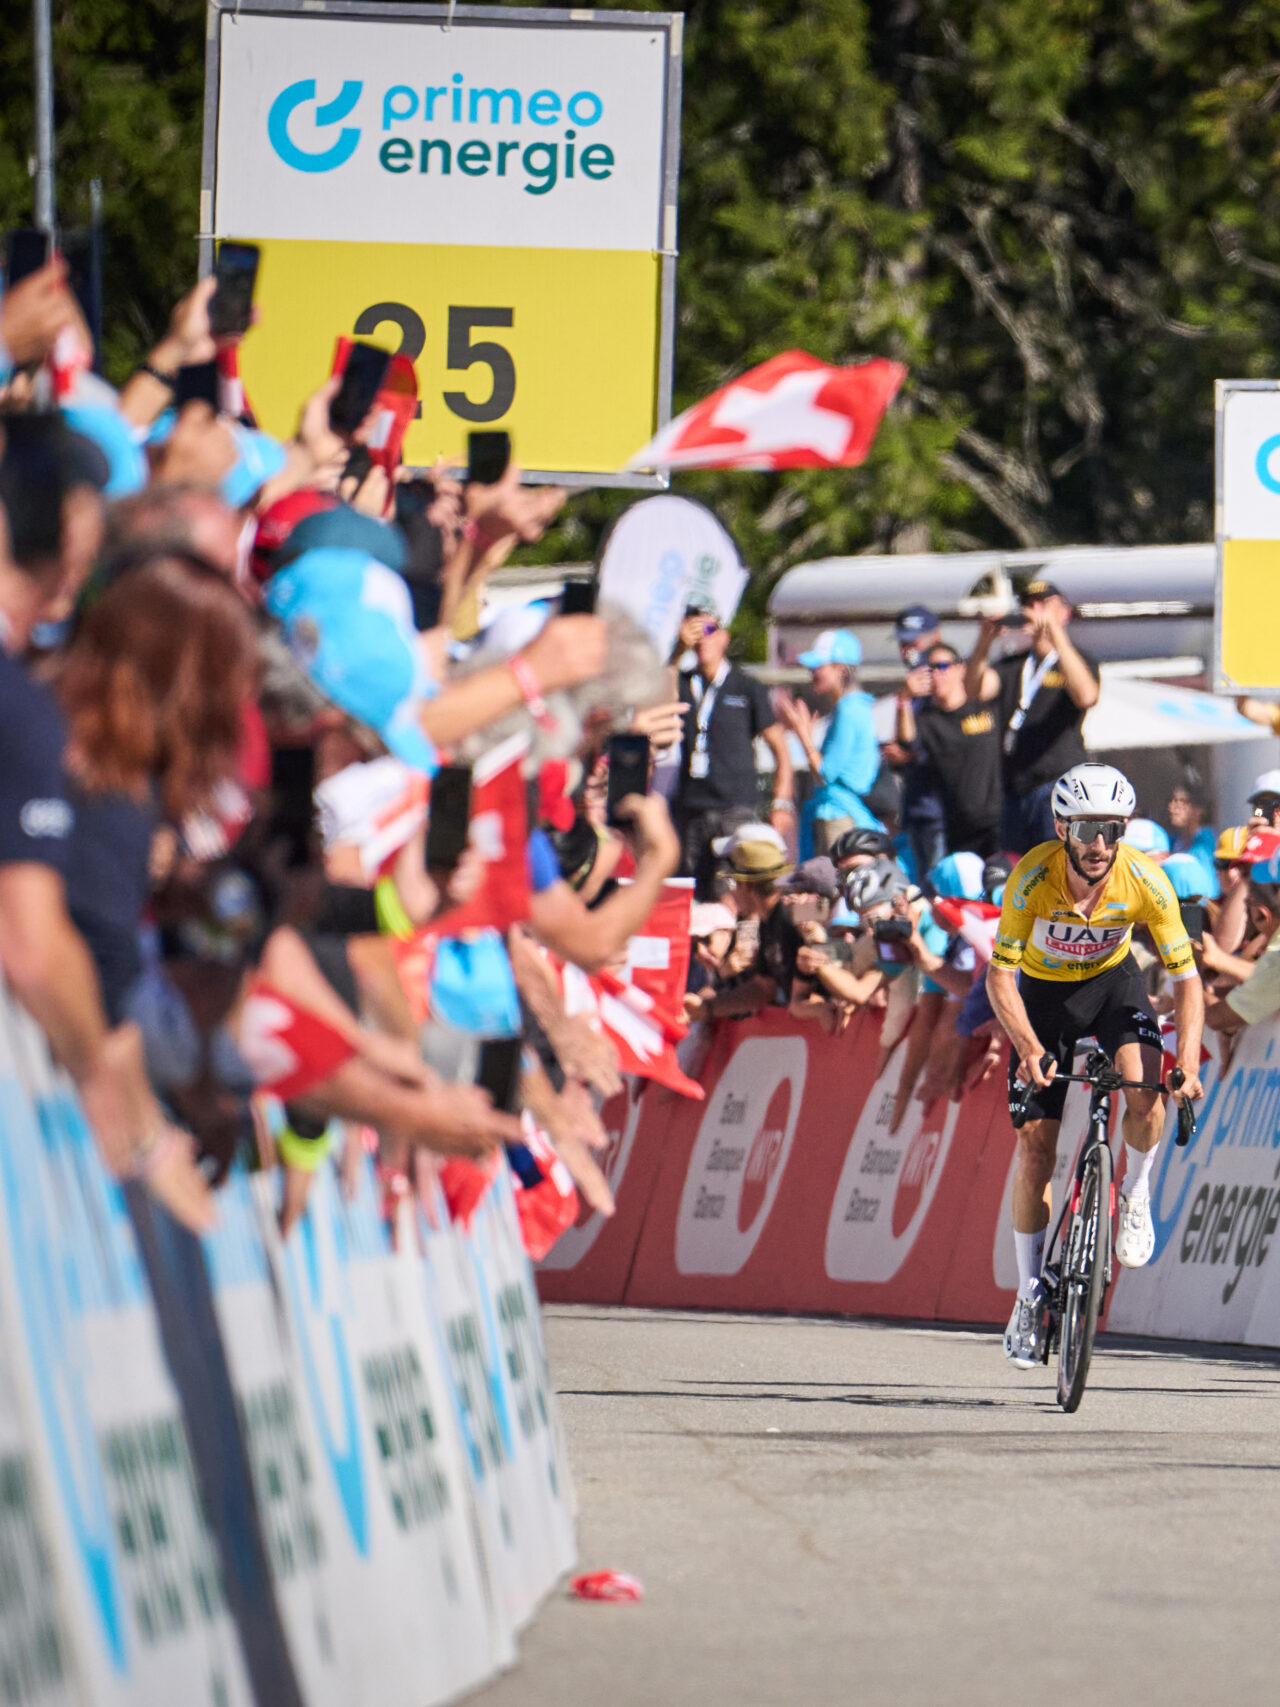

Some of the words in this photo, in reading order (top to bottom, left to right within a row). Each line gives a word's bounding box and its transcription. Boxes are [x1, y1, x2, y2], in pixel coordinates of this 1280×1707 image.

[382, 73, 604, 131] primeo
[379, 129, 616, 196] energie
[1047, 924, 1124, 944] UAE
